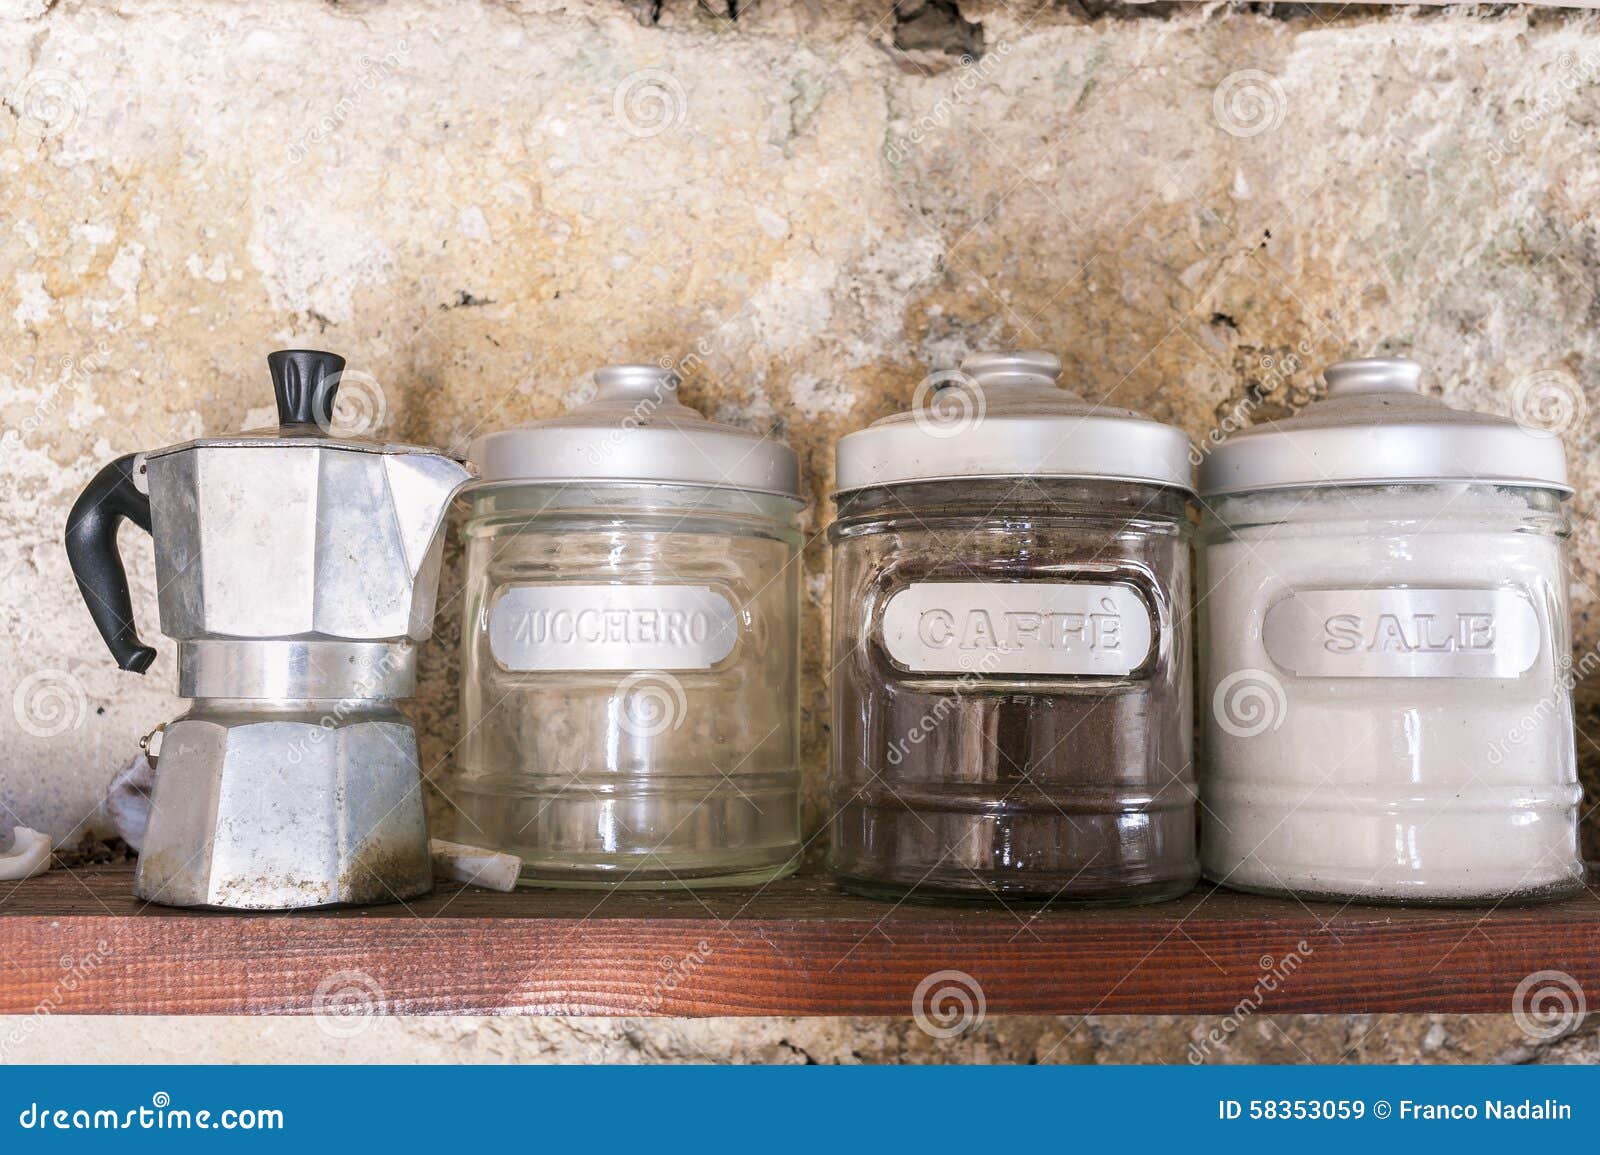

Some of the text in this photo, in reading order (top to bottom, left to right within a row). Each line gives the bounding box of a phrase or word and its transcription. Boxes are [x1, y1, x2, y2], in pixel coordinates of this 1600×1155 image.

[513, 608, 711, 646] ZUCCHERO
[917, 596, 1121, 651] CAFFÈ
[1322, 611, 1497, 654] SALE
